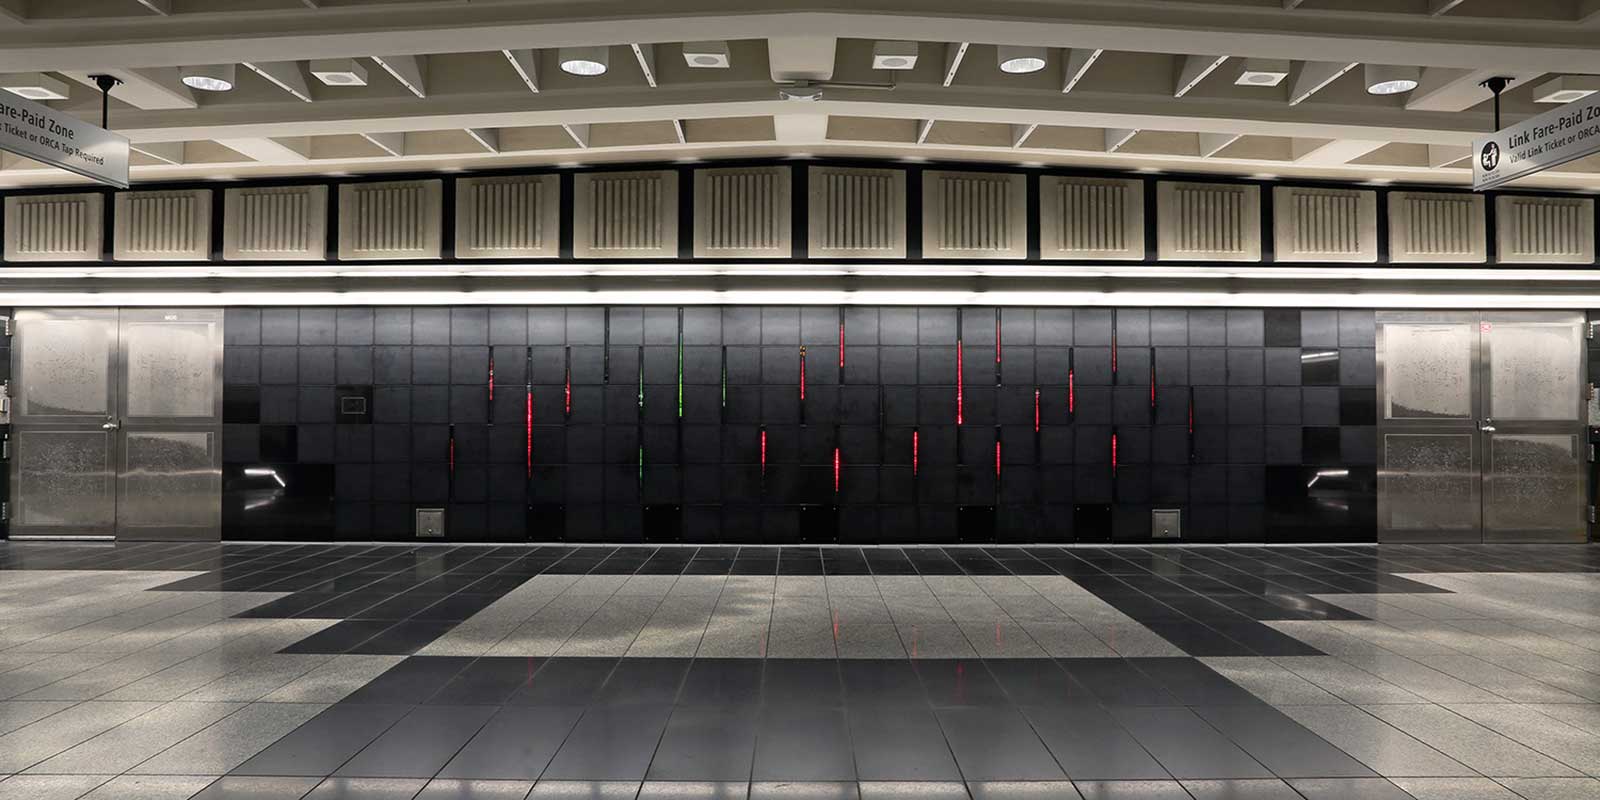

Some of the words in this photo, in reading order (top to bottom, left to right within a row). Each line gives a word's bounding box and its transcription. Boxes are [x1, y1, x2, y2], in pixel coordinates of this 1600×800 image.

[4, 123, 28, 139] Ticket
[29, 133, 38, 143] or
[39, 135, 60, 151] ORCA
[62, 143, 74, 156] Tap
[75, 148, 104, 165] Required
[48, 119, 74, 140] Zone
[1508, 130, 1530, 149] Link
[1533, 109, 1583, 140] Fare-Paid
[1509, 151, 1526, 163] Valid
[1527, 145, 1544, 158] Link
[1544, 138, 1567, 152] Ticket
[1567, 134, 1577, 144] or
[1577, 125, 1600, 140] ORCA
